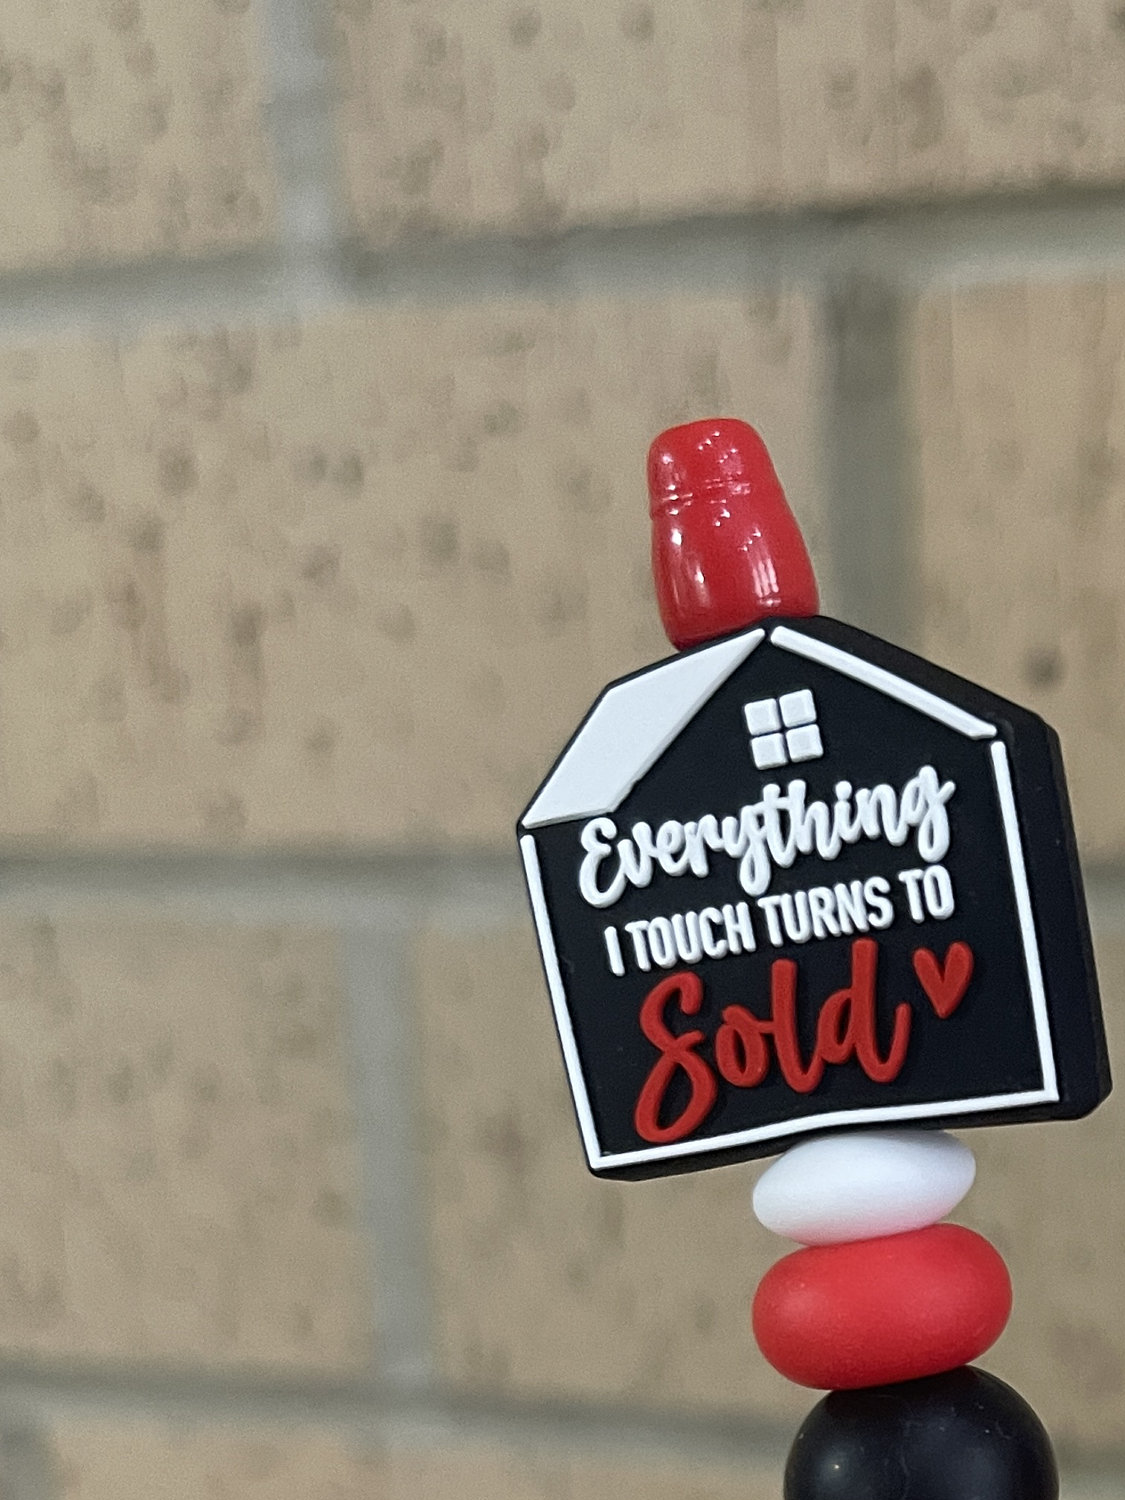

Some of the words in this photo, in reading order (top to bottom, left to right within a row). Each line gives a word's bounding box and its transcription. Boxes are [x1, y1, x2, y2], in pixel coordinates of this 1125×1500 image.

[579, 764, 956, 908] Everything
[604, 925, 625, 977] I
[624, 900, 756, 972] TOUCH
[757, 876, 894, 950] TURNS
[899, 864, 955, 923] TO
[634, 937, 912, 1144] Sold
